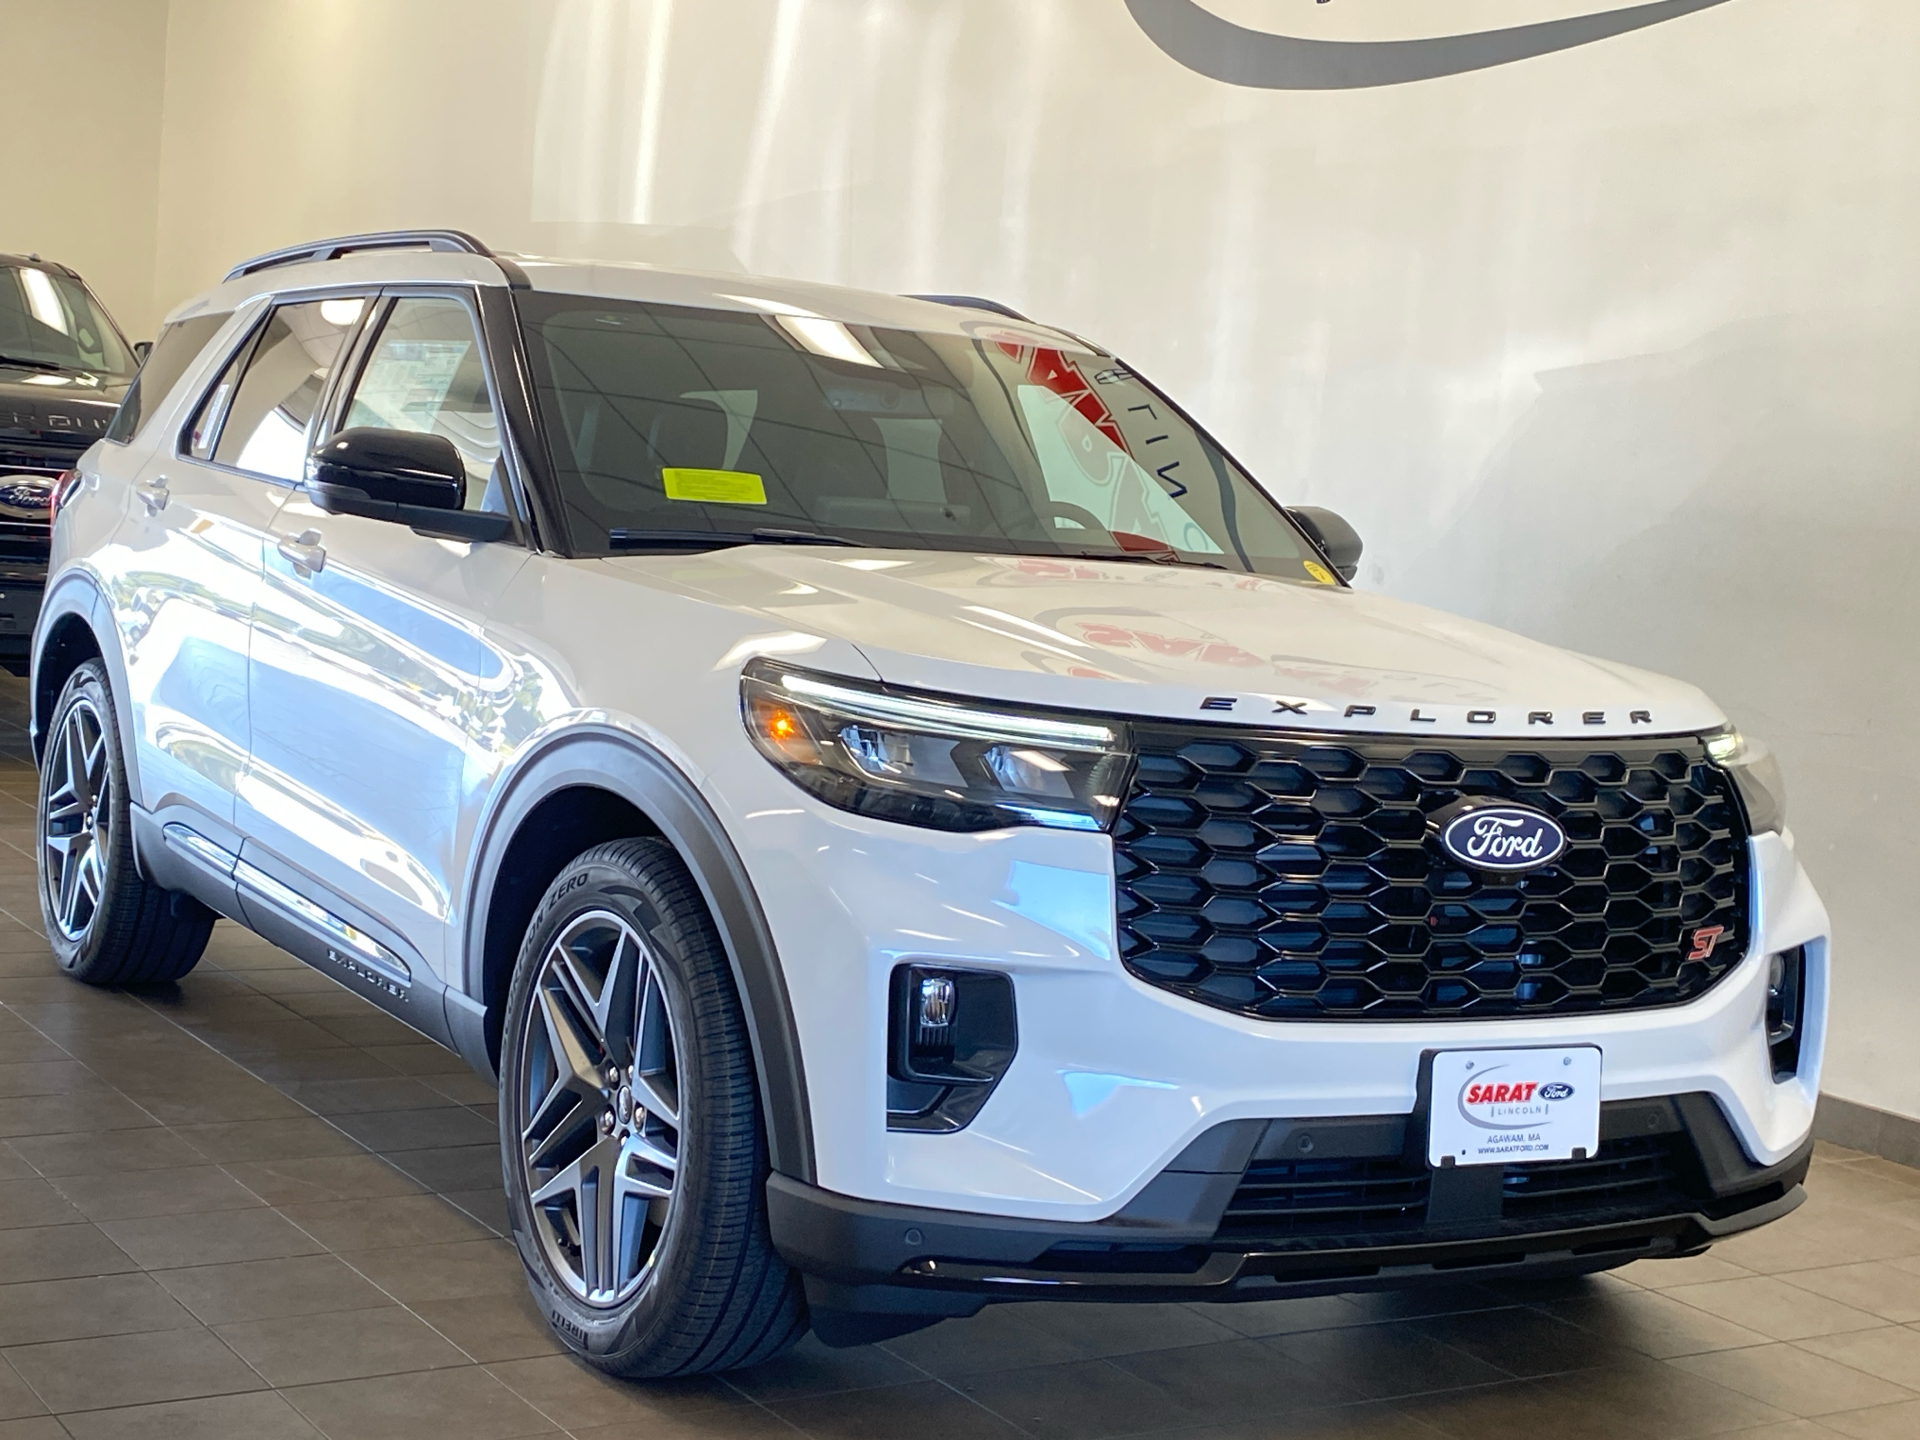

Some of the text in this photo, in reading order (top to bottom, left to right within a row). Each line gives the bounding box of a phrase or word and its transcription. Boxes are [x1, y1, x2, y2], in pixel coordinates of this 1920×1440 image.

[1199, 695, 1653, 725] EXPLORER
[1467, 816, 1544, 858] Ford
[549, 872, 589, 909] ZERO
[1688, 924, 1725, 961] ST
[1466, 1081, 1569, 1105] SARAT Ford
[1497, 1105, 1542, 1116] LINCOLN
[1478, 1143, 1550, 1154] WWW.SARATFORD.COM
[1487, 1132, 1541, 1144] AGAWAM, MA
[551, 1308, 589, 1350] PIRELLI
